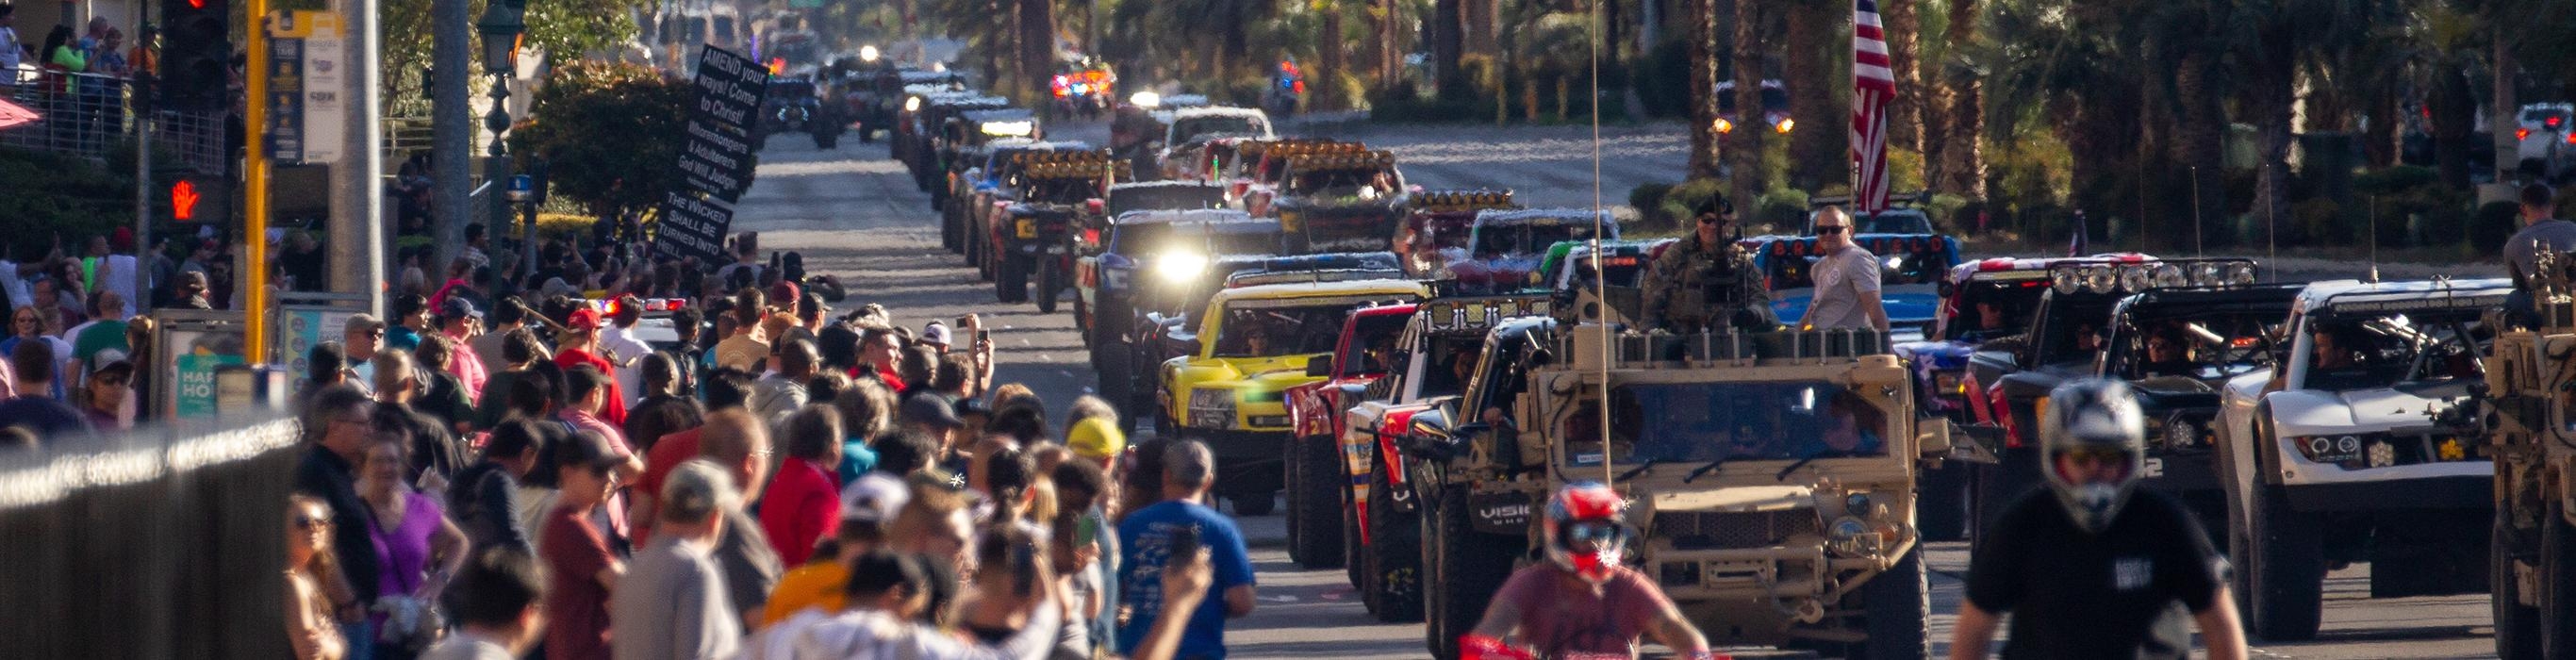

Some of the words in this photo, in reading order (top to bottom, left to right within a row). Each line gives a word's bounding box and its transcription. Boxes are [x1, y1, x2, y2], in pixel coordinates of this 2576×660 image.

[702, 48, 741, 75] AMEND
[740, 67, 766, 85] your
[699, 74, 729, 95] ways!
[729, 82, 756, 107] Come
[701, 95, 711, 112] to
[712, 100, 745, 124] Christ!
[687, 120, 748, 155] Whoremongers
[679, 155, 694, 172] God
[694, 161, 709, 178] Will
[687, 140, 695, 153] &
[694, 143, 737, 170] Adulterers
[668, 191, 687, 208] THE
[687, 200, 727, 223] WICKED
[657, 222, 695, 247] TURNED
[697, 238, 719, 256] INTO
[669, 209, 700, 231] SHALL
[701, 223, 717, 238] BE
[183, 384, 211, 398] HO
